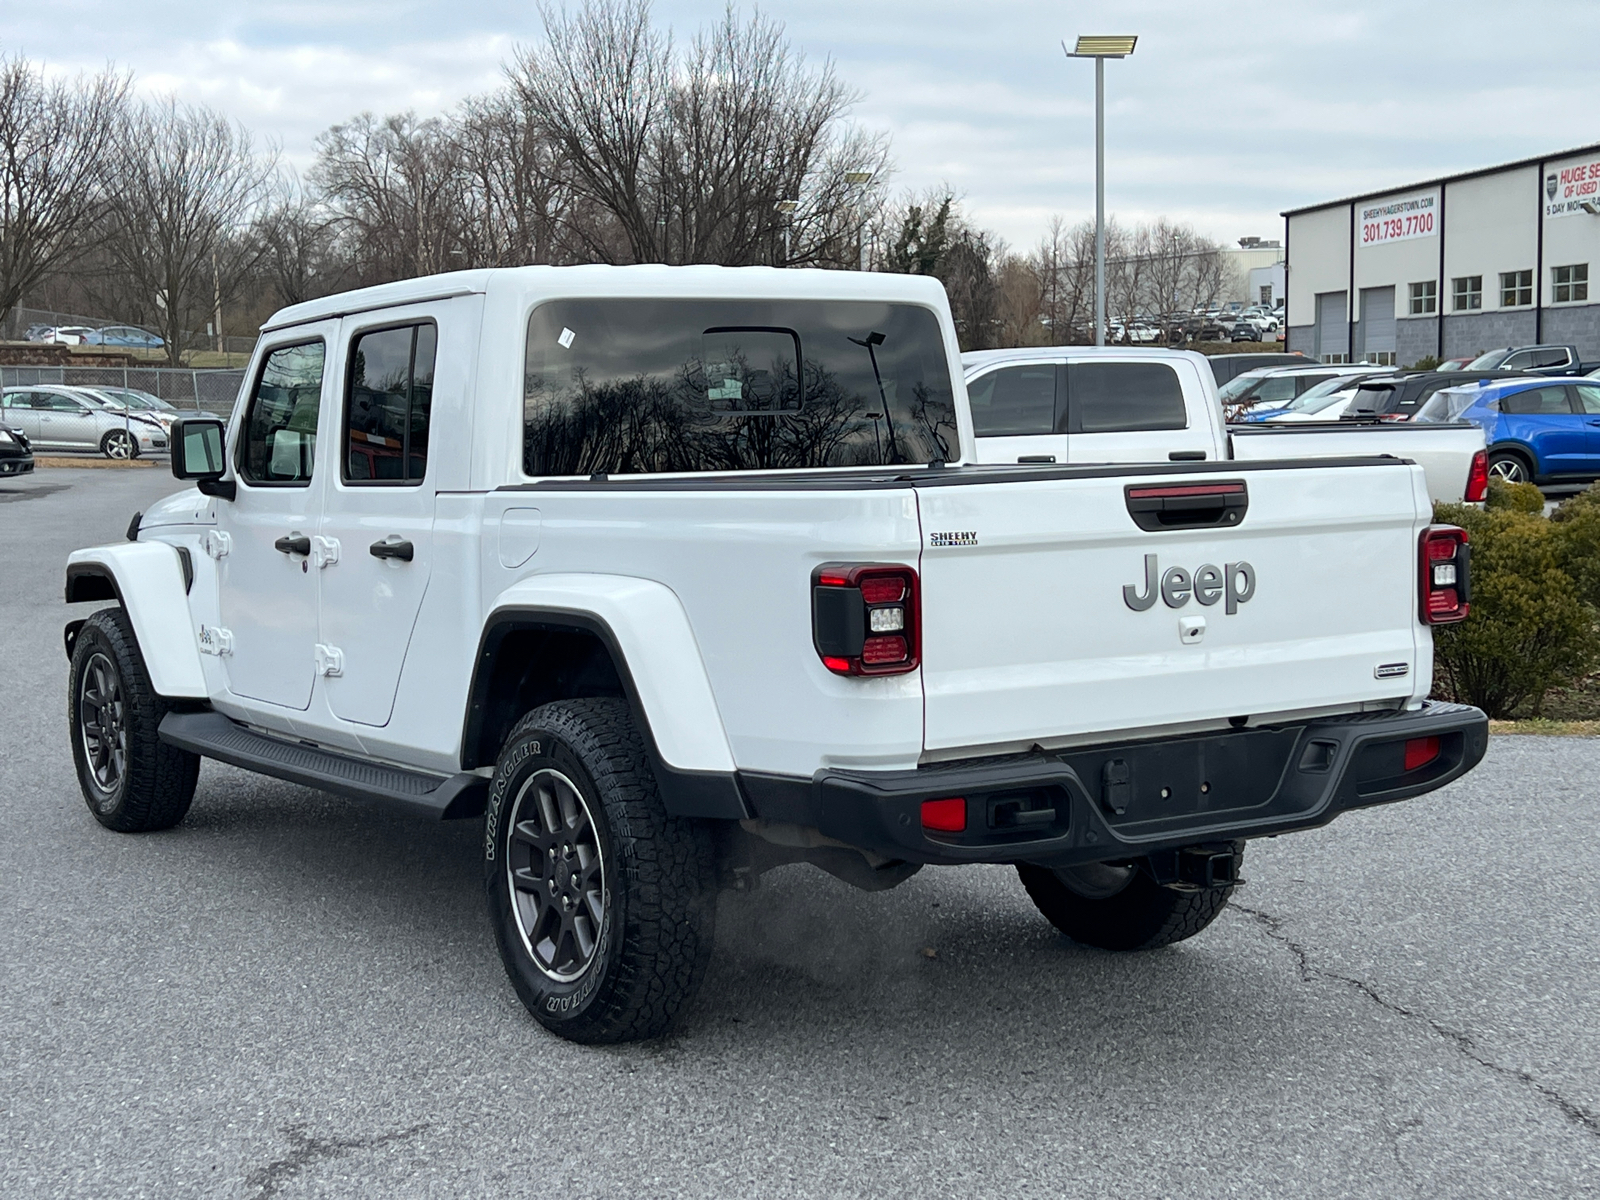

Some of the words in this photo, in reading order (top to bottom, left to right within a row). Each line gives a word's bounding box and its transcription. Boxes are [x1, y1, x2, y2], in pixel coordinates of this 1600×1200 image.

[1560, 166, 1587, 185] HUGE
[1564, 185, 1575, 198] OF
[1576, 181, 1597, 196] USED
[1363, 197, 1433, 220] SHEEHYHAGERSTOWN.COM
[1547, 205, 1551, 215] 5
[1552, 203, 1565, 214] DAY
[1363, 212, 1433, 243] 301.739.7700
[930, 531, 977, 540] SHEEHY
[1122, 553, 1256, 615] Jeep
[486, 741, 541, 860] WRANGLER
[547, 888, 611, 1011] GOODYEAR
